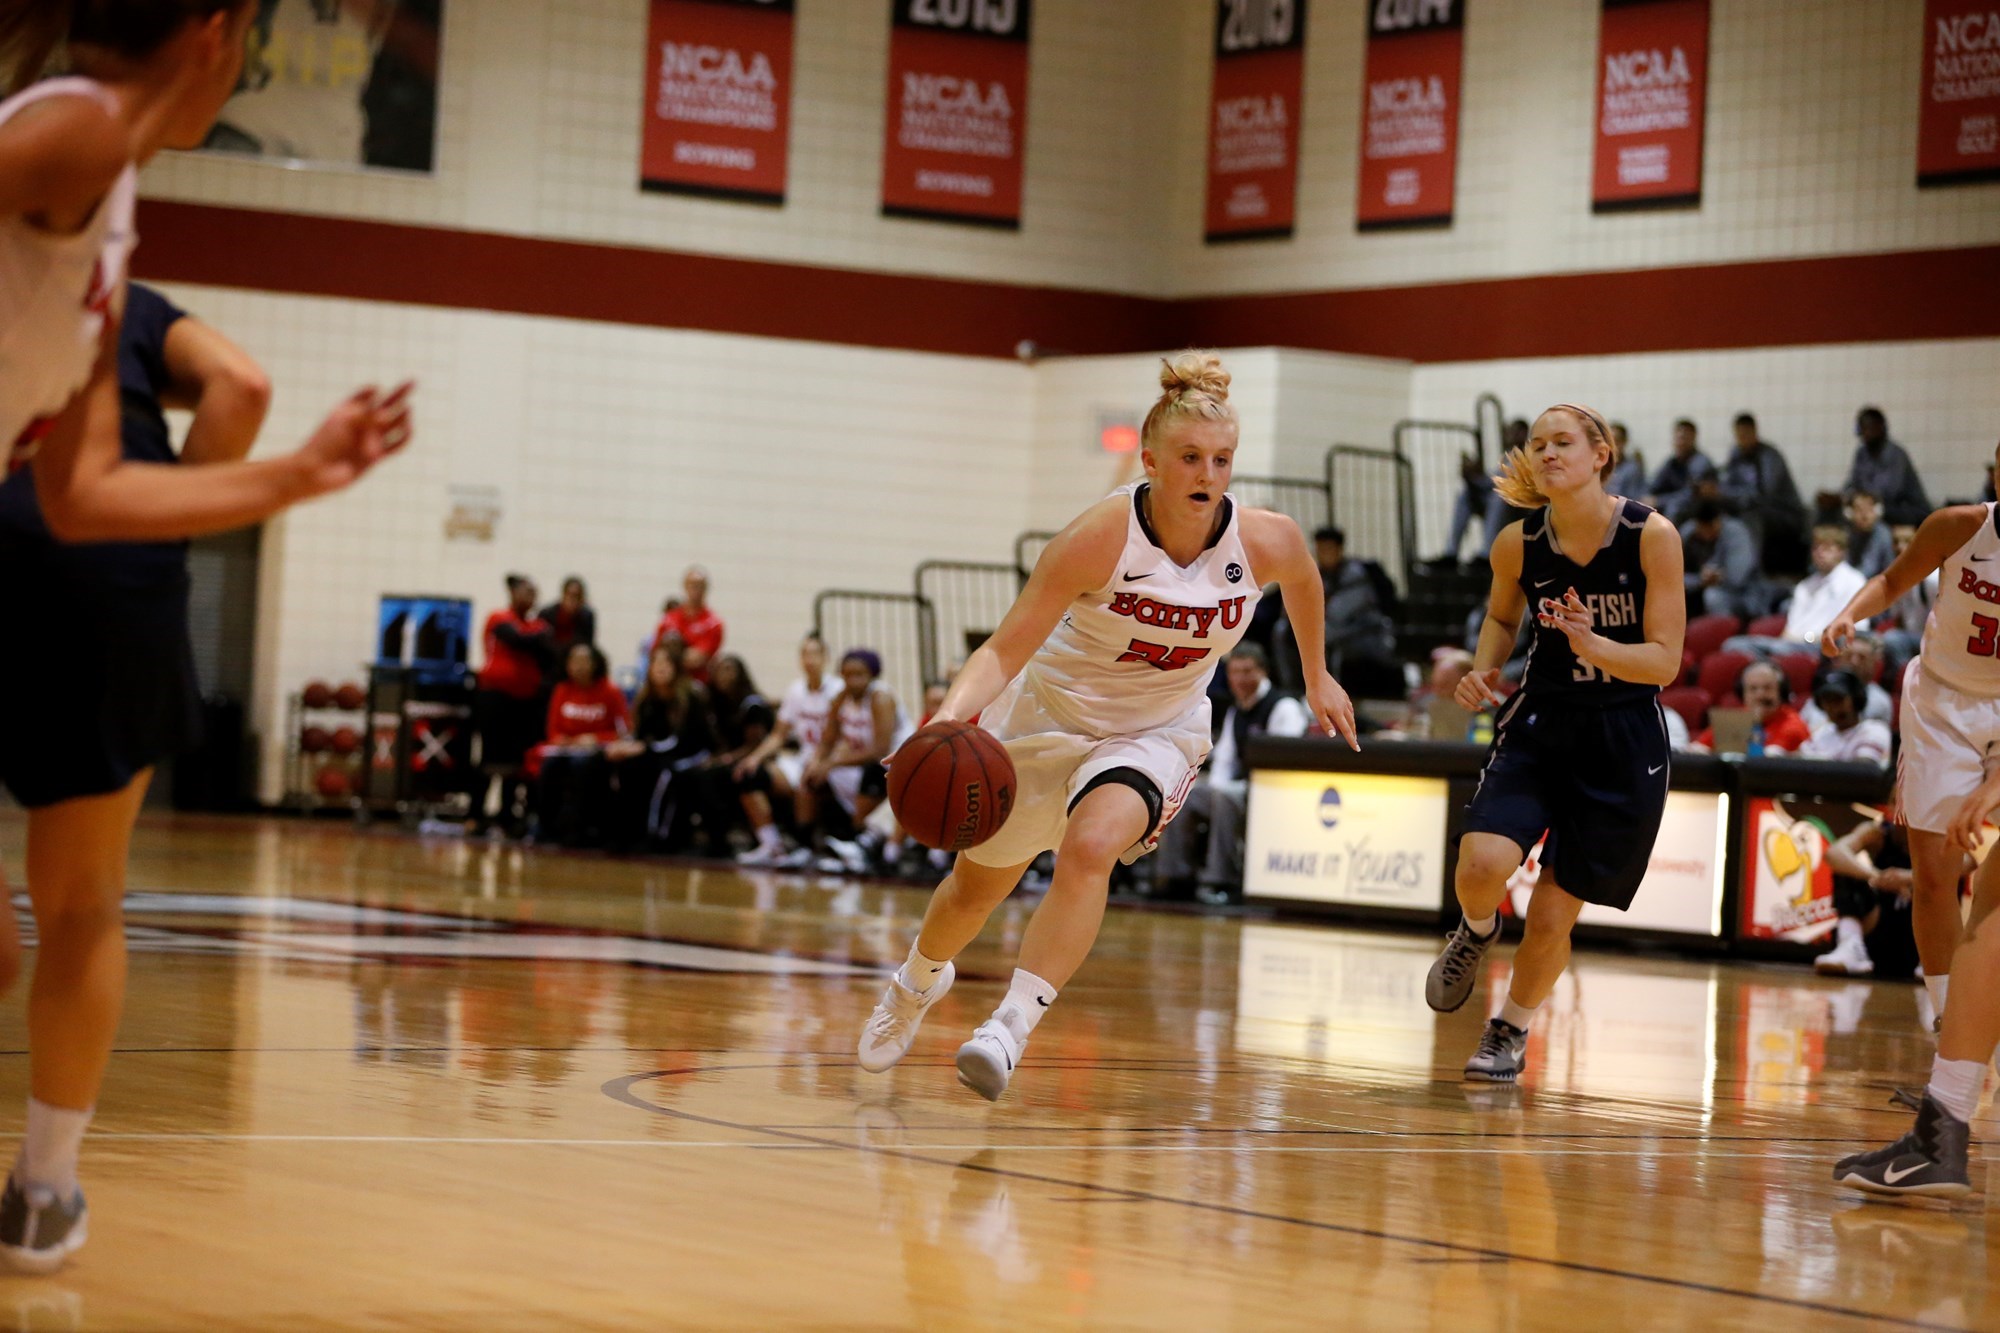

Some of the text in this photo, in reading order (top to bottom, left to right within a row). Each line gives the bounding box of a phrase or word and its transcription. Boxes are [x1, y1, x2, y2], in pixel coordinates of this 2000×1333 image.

[660, 40, 777, 90] NCAA
[1604, 47, 1691, 91] NCAA
[901, 71, 1013, 120] NCAA
[1226, 568, 1242, 579] CO
[1108, 591, 1246, 639] Barry U
[1538, 592, 1637, 629] SAFISH
